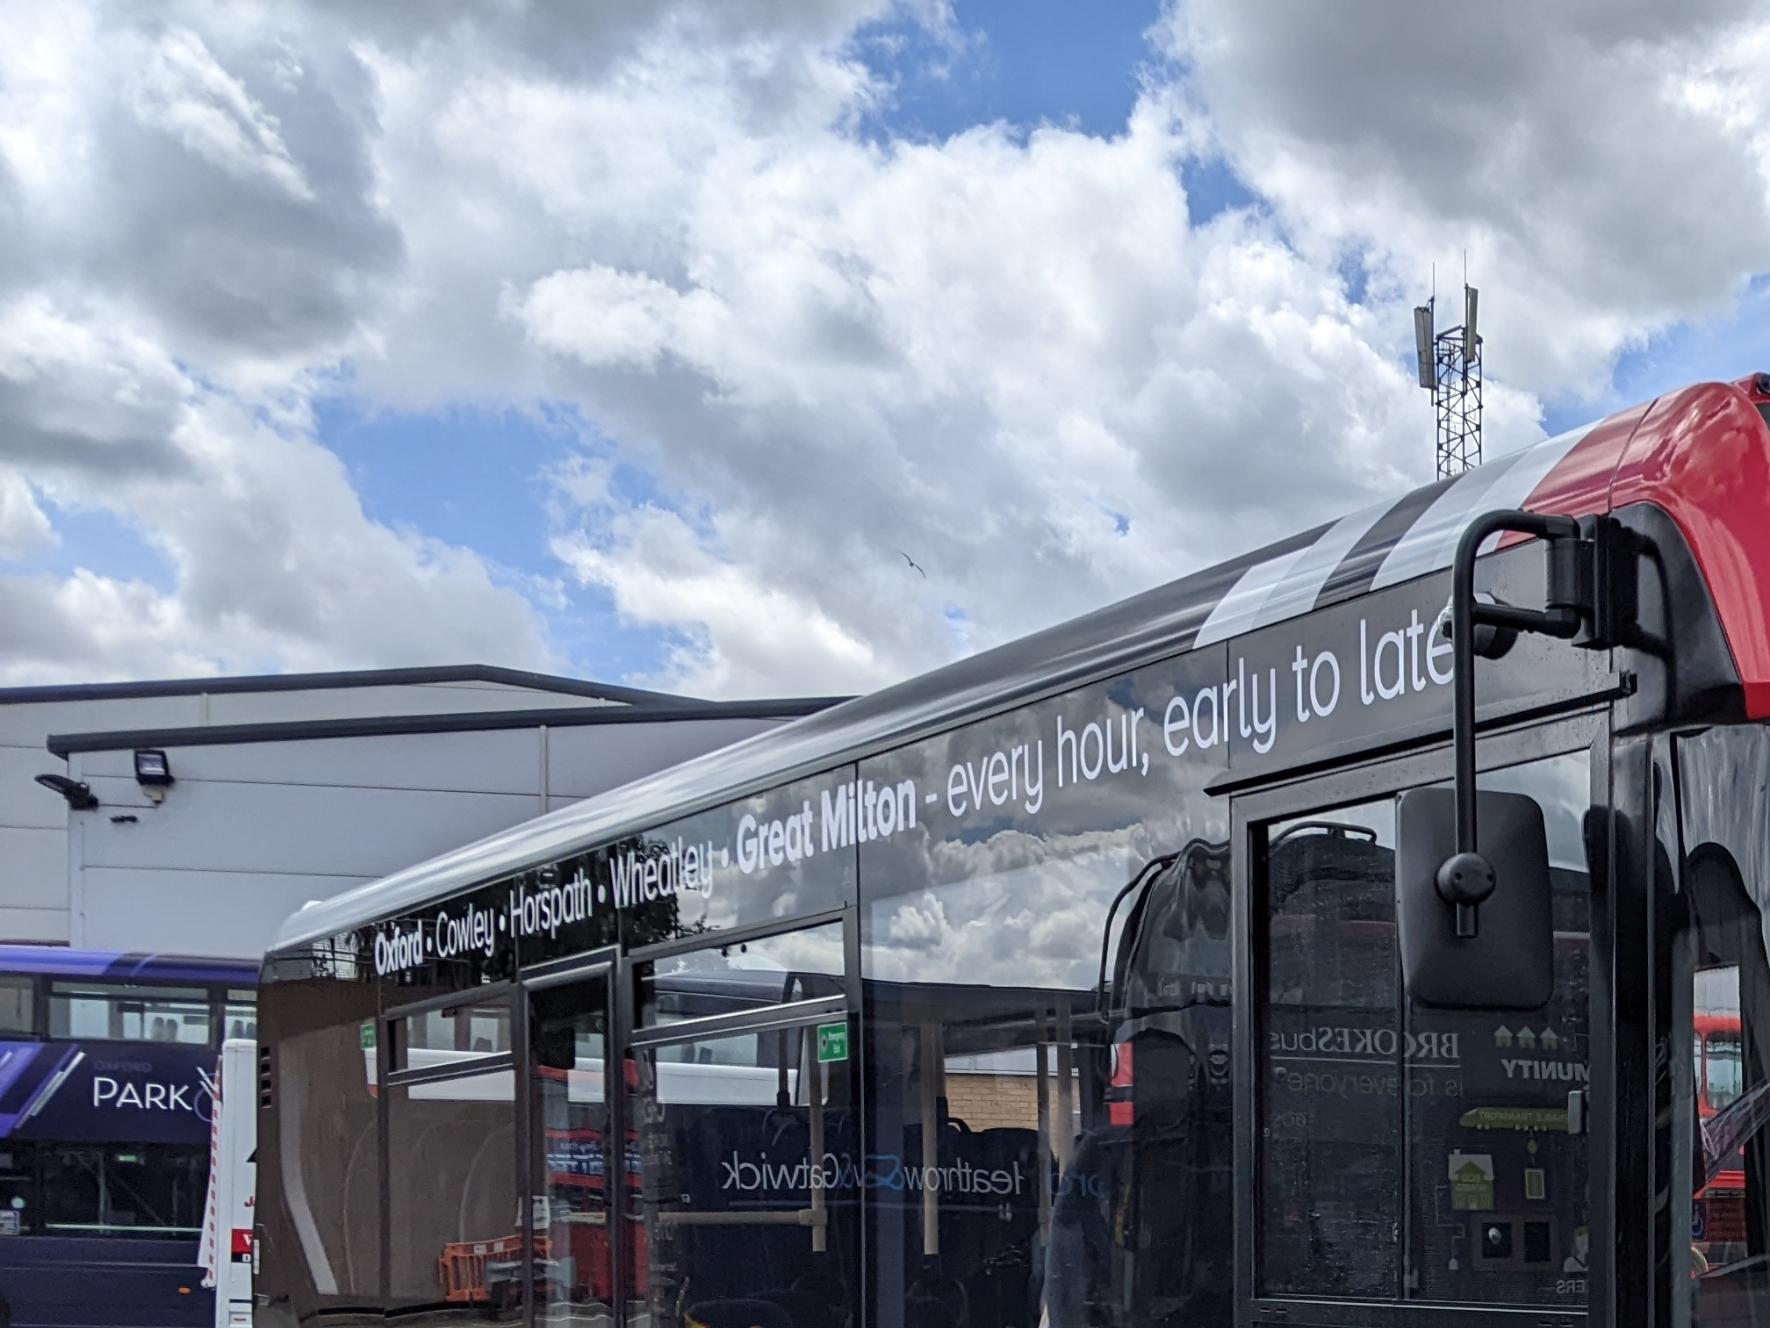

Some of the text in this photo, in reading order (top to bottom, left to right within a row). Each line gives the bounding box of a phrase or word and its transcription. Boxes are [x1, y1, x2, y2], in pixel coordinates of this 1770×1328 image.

[374, 608, 1454, 977] Oxford Cowley Horspath Wheatley Great Milton every hour, early to late
[93, 1076, 193, 1111] PARK
